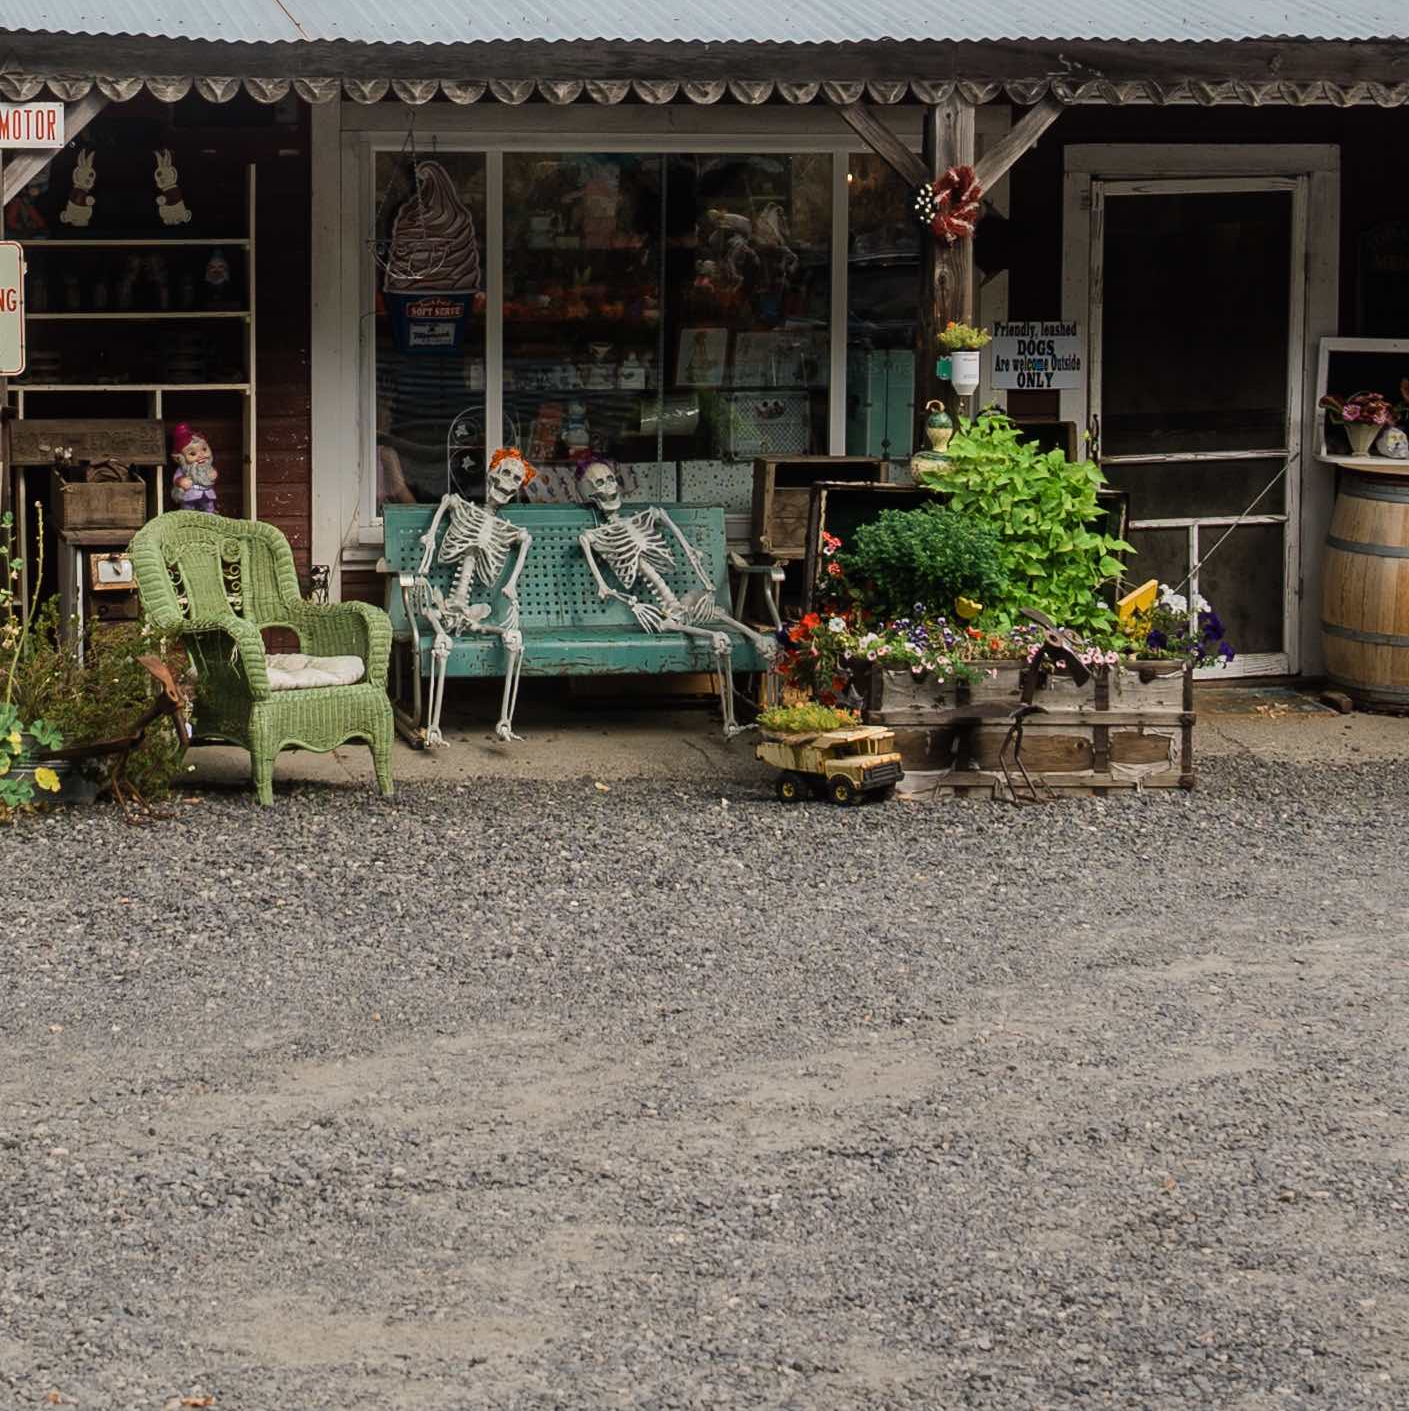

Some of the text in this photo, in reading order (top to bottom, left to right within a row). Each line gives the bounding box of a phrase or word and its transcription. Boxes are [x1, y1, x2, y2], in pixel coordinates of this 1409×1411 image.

[994, 322, 1077, 339] Friendly, leashed
[1017, 340, 1055, 356] DOGS
[995, 354, 1081, 372] Are welcome Outside
[1017, 372, 1054, 388] ONLY
